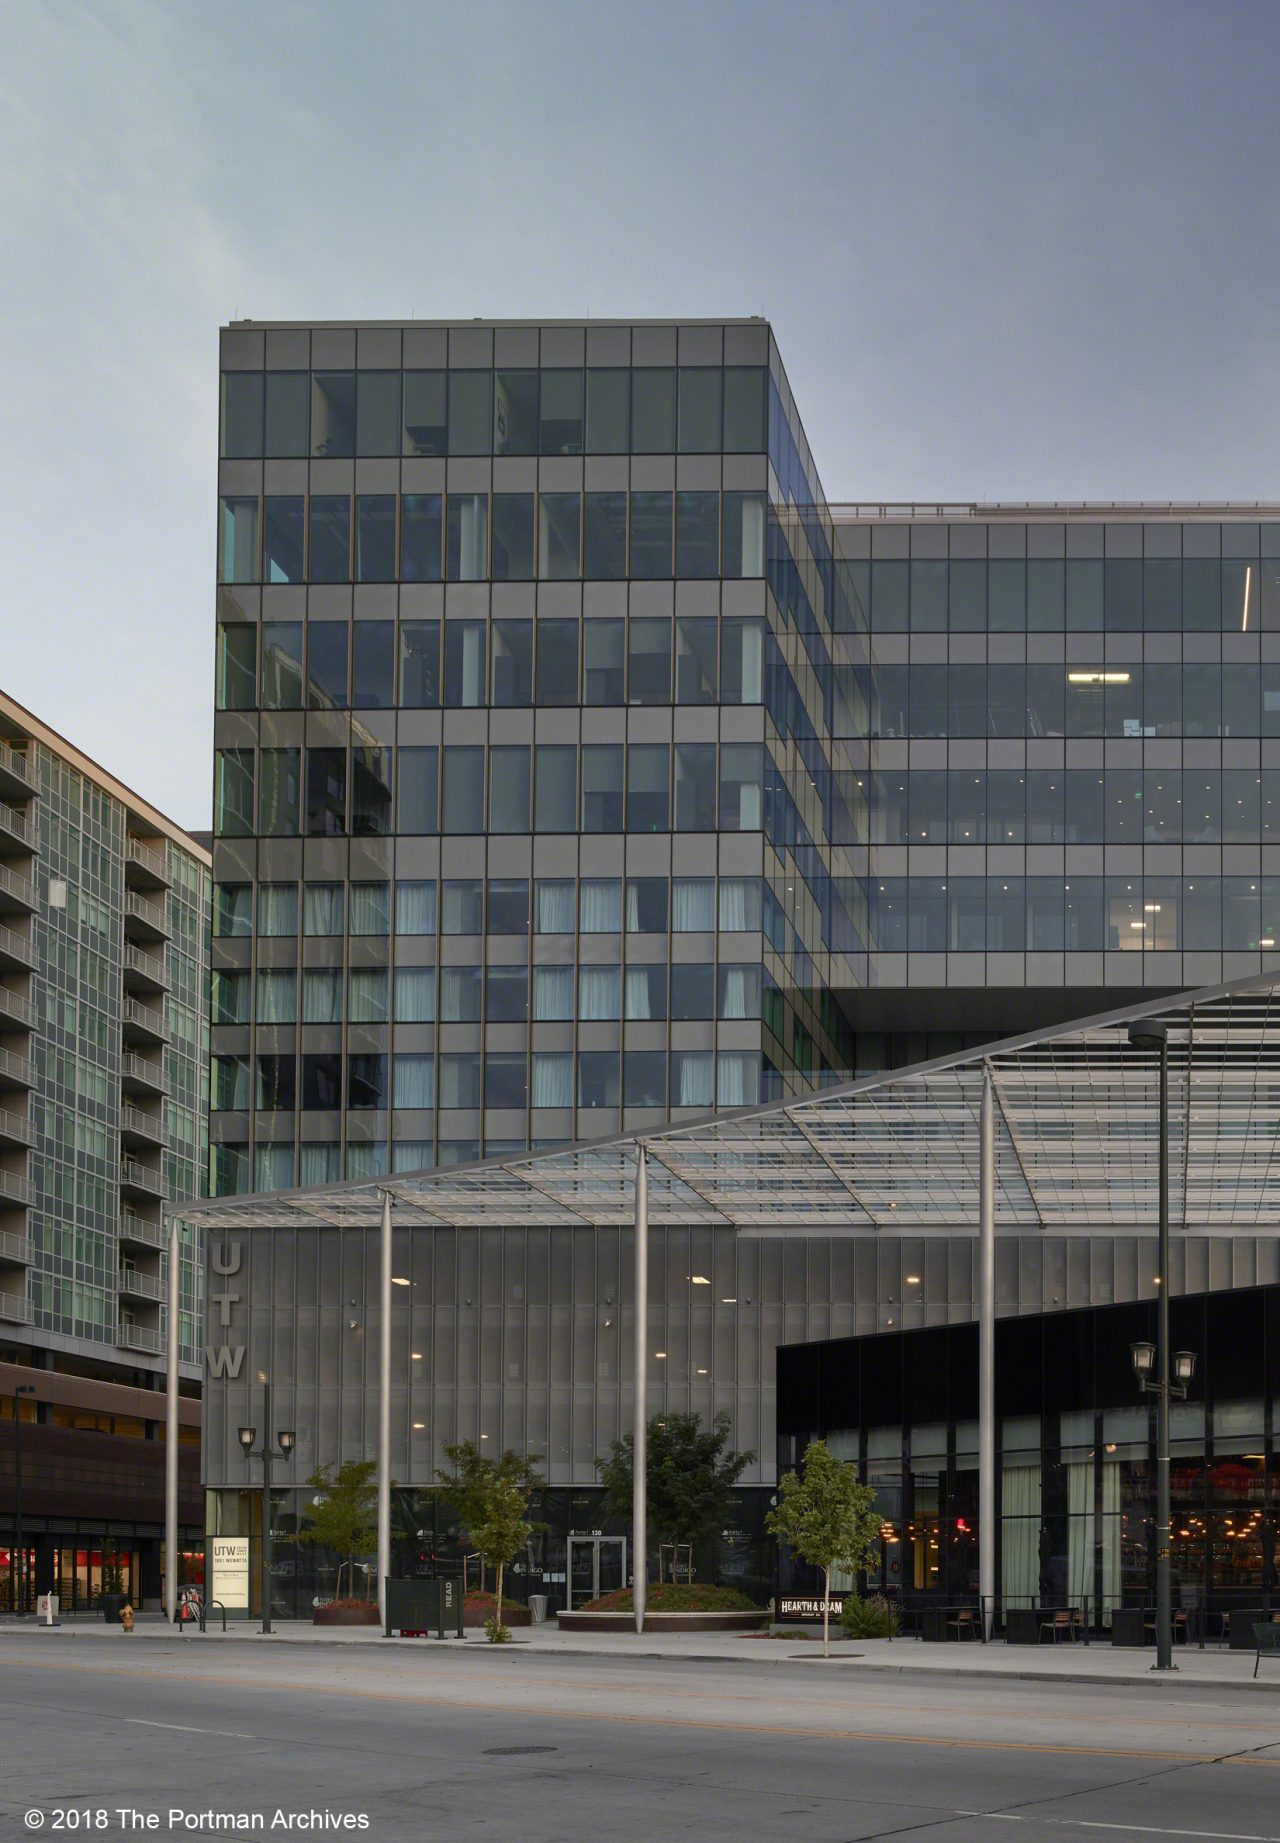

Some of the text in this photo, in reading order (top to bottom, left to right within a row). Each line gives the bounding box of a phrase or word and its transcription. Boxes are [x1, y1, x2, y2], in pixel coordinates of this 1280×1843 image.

[214, 1546, 236, 1556] UTW
[445, 1581, 453, 1608] READ
[781, 1601, 812, 1613] HEARTH
[813, 1601, 818, 1612] &
